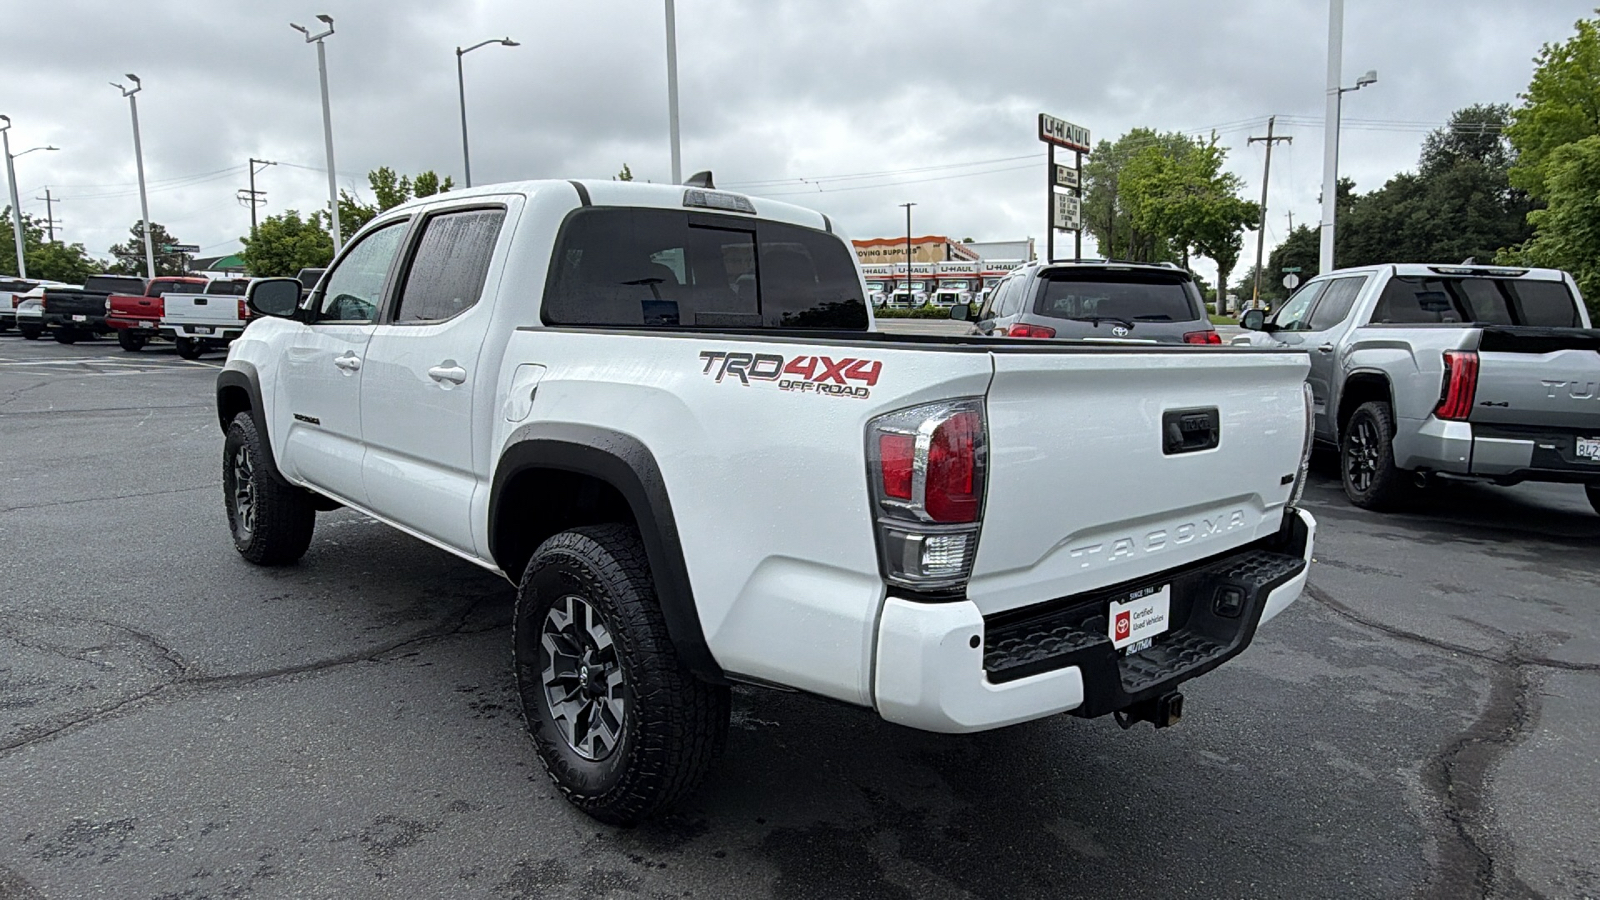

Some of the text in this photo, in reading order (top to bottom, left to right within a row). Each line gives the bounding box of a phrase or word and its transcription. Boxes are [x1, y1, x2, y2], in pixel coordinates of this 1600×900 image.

[1044, 118, 1090, 146] U-HAUL
[856, 249, 881, 257] OVING
[778, 379, 871, 399] OFF ROAD
[1070, 509, 1245, 568] TACOMA
[1133, 606, 1153, 620] Certified
[1133, 615, 1164, 631] Used Vehicles
